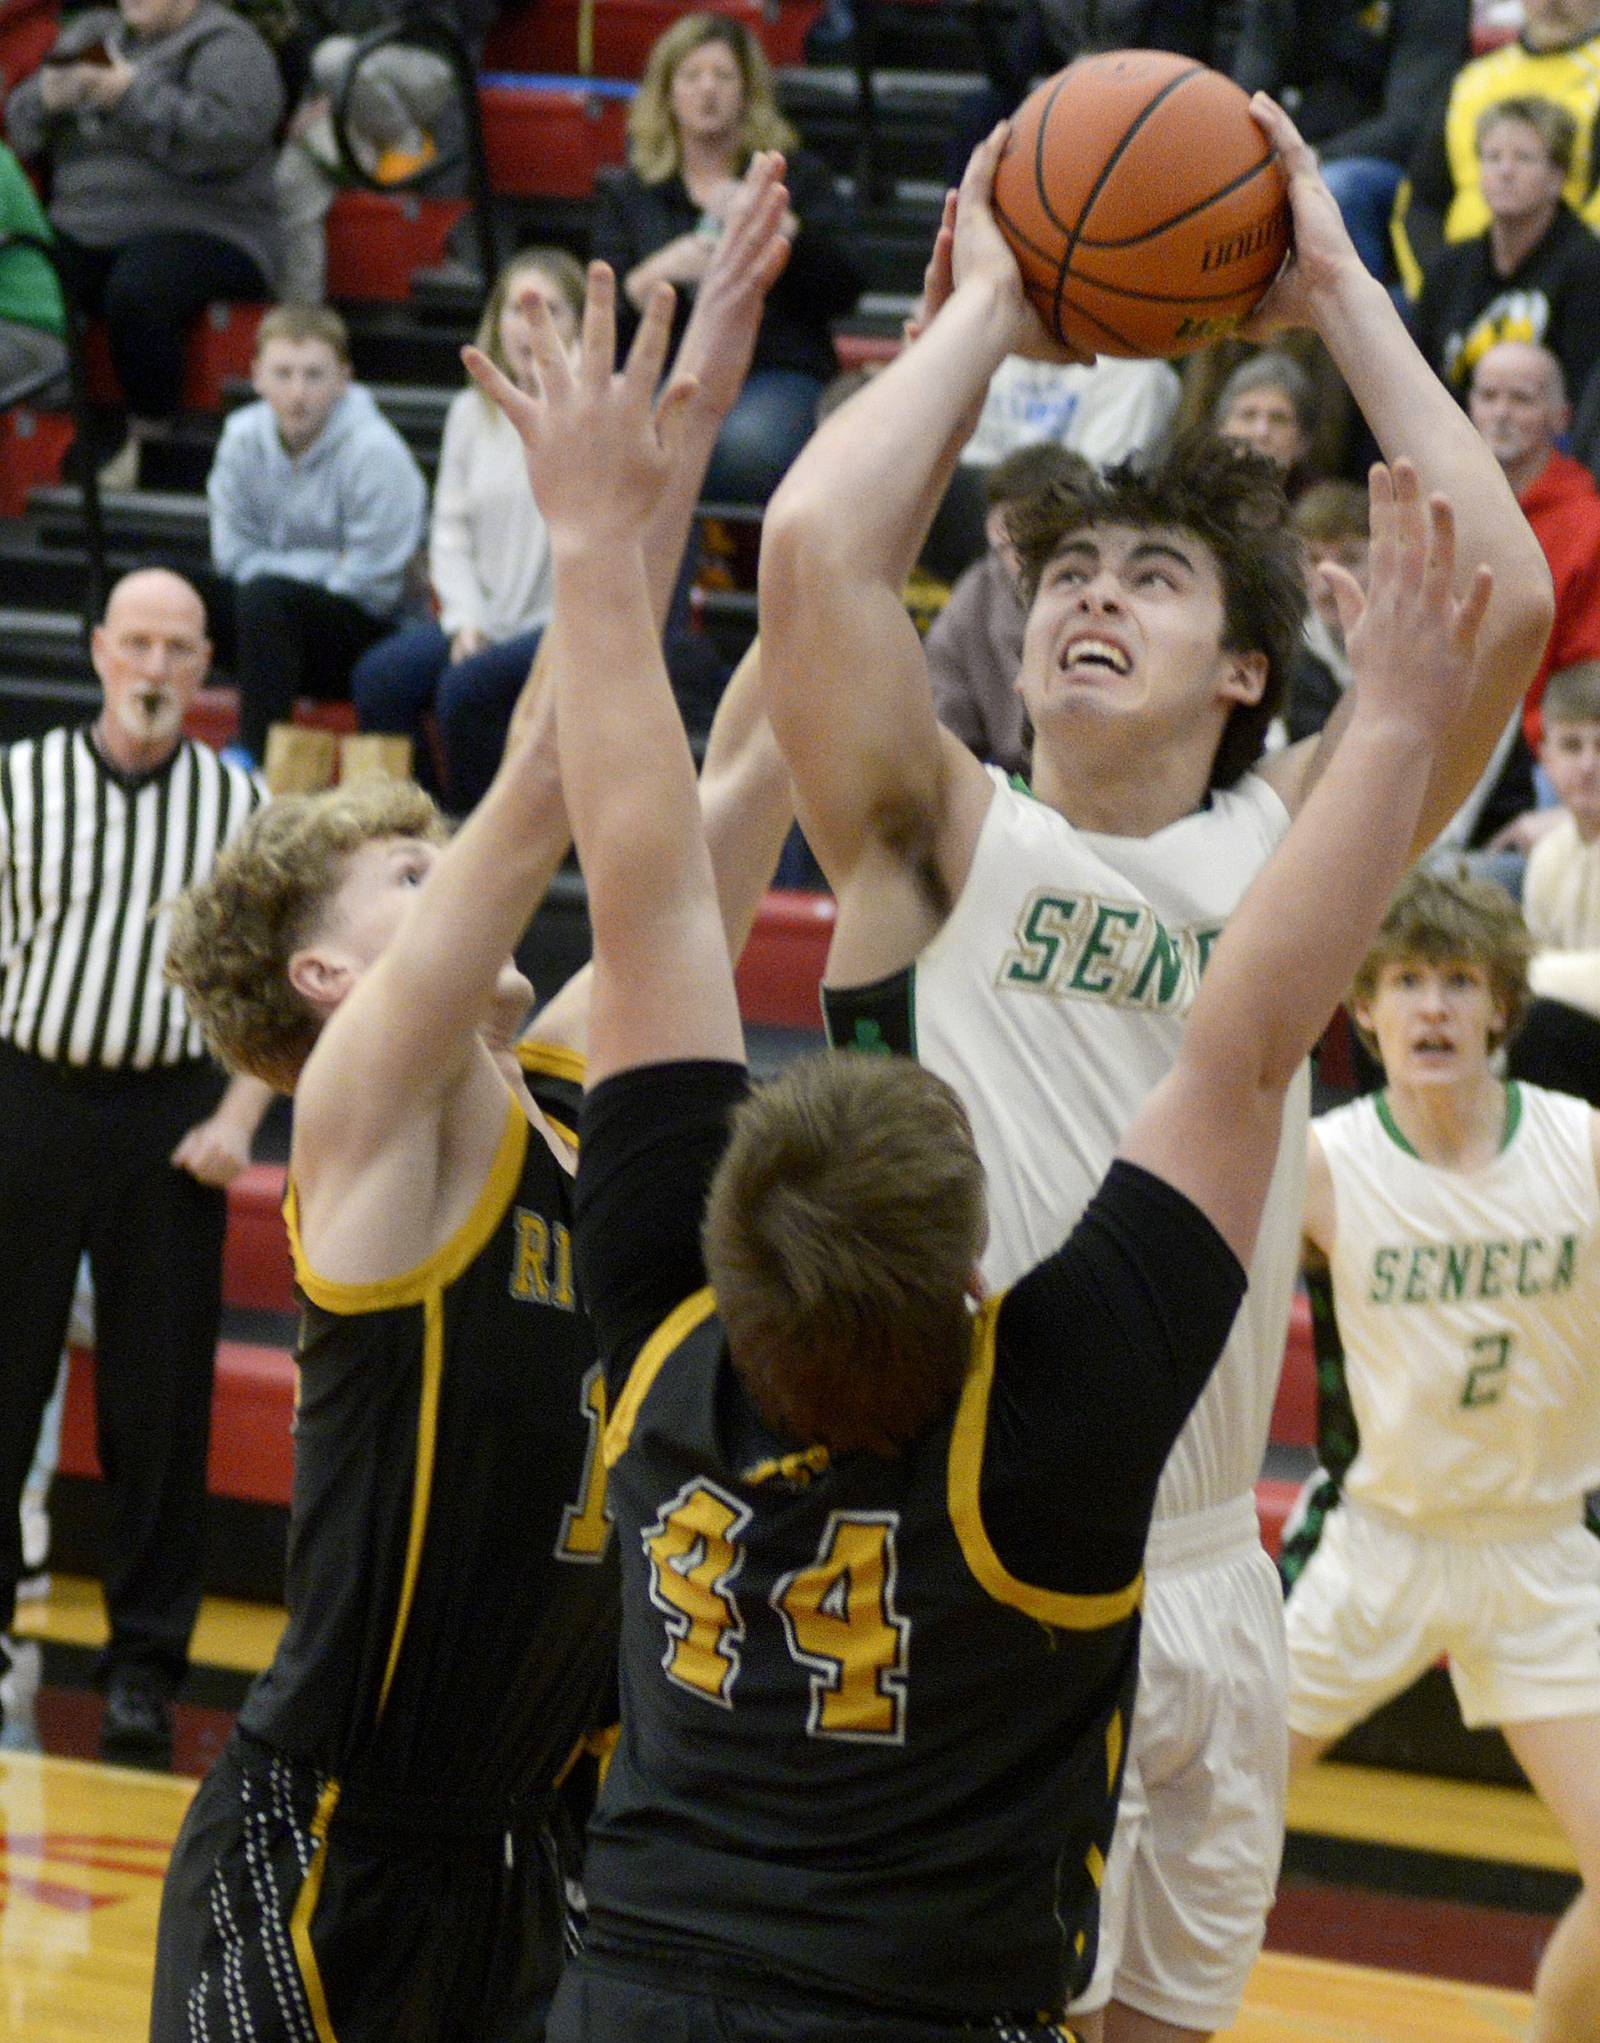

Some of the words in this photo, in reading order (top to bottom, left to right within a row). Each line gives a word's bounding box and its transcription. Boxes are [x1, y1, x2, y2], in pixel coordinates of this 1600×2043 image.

[510, 1206, 590, 1314] RI
[1369, 1233, 1576, 1305] SENECA
[1460, 1331, 1513, 1408] 2
[640, 1476, 912, 1746] 44
